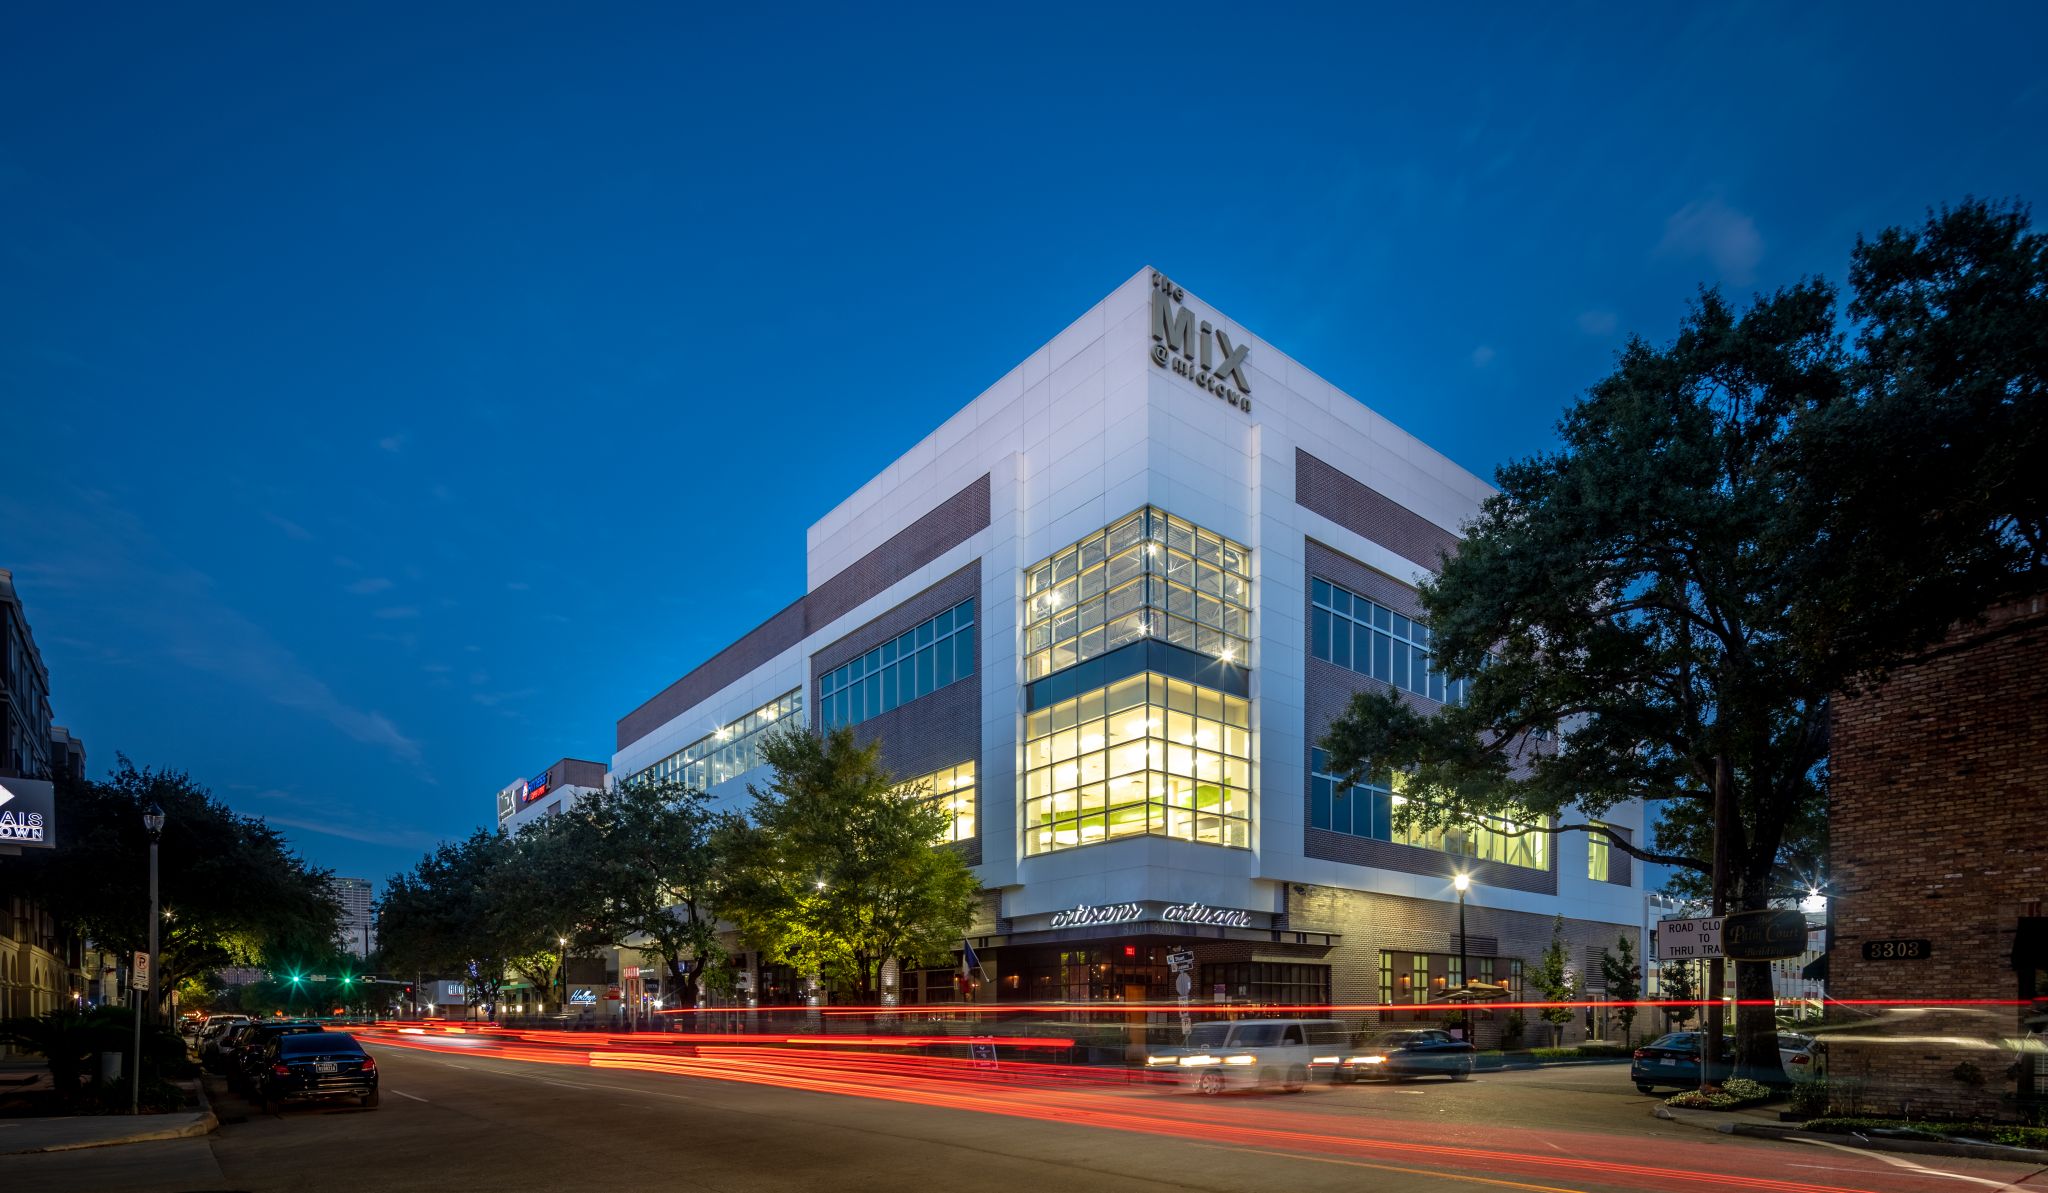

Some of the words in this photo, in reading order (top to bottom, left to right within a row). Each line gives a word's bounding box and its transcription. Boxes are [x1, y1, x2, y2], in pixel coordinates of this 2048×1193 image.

[0, 811, 43, 827] AIS
[0, 826, 43, 841] OWN
[1051, 904, 1143, 928] artisans
[1163, 902, 1252, 927] artisans
[1669, 922, 1694, 933] ROAD
[1702, 920, 1720, 931] CLO
[1698, 933, 1710, 943] TO
[1669, 946, 1694, 956] THRU
[1871, 941, 1919, 958] 3303
